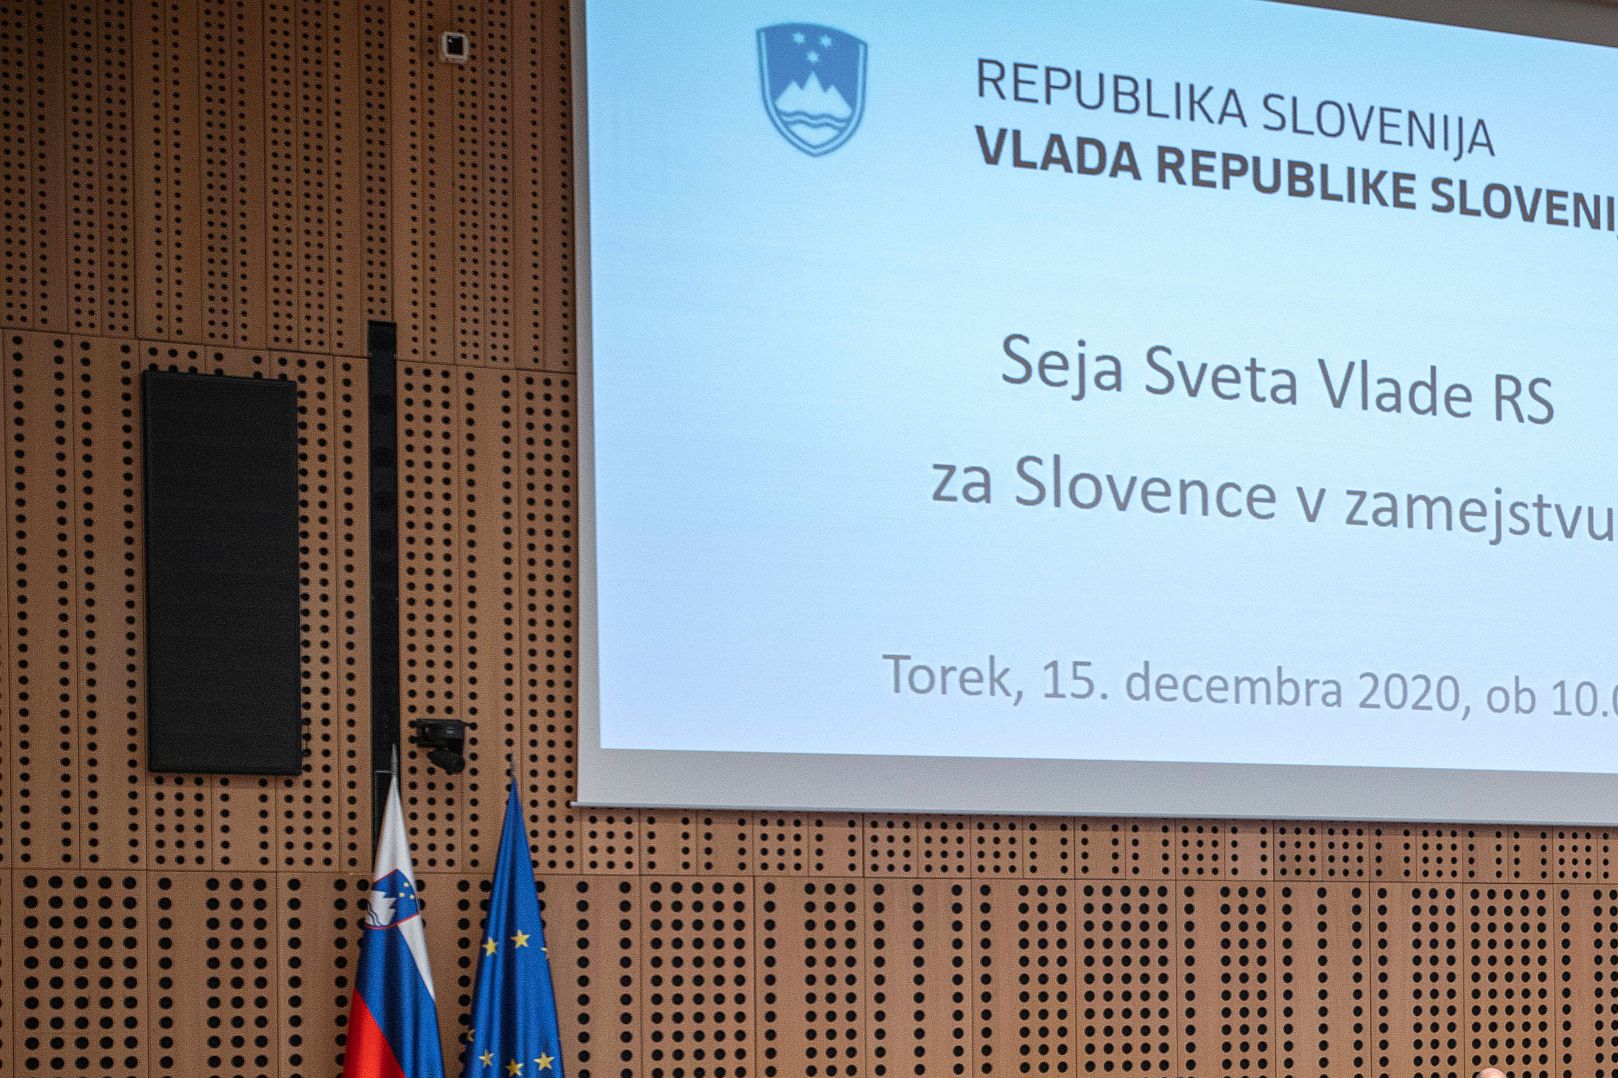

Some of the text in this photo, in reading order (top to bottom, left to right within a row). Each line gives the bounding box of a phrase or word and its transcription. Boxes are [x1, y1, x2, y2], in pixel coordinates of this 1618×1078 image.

[976, 57, 1496, 163] REPUBLIKA SLOVENIJA
[973, 123, 1143, 182] VLADA
[1156, 144, 1416, 211] REPUBLIKE
[1001, 332, 1555, 426] Seja Sveta Vlade RS
[931, 453, 1614, 547] za Slovence v zamejstvu
[881, 653, 1024, 707] Torek,
[1043, 659, 1108, 701] 15.
[1125, 659, 1342, 709] decembra
[1358, 671, 1471, 721] 2020,
[1486, 674, 1537, 716] ob
